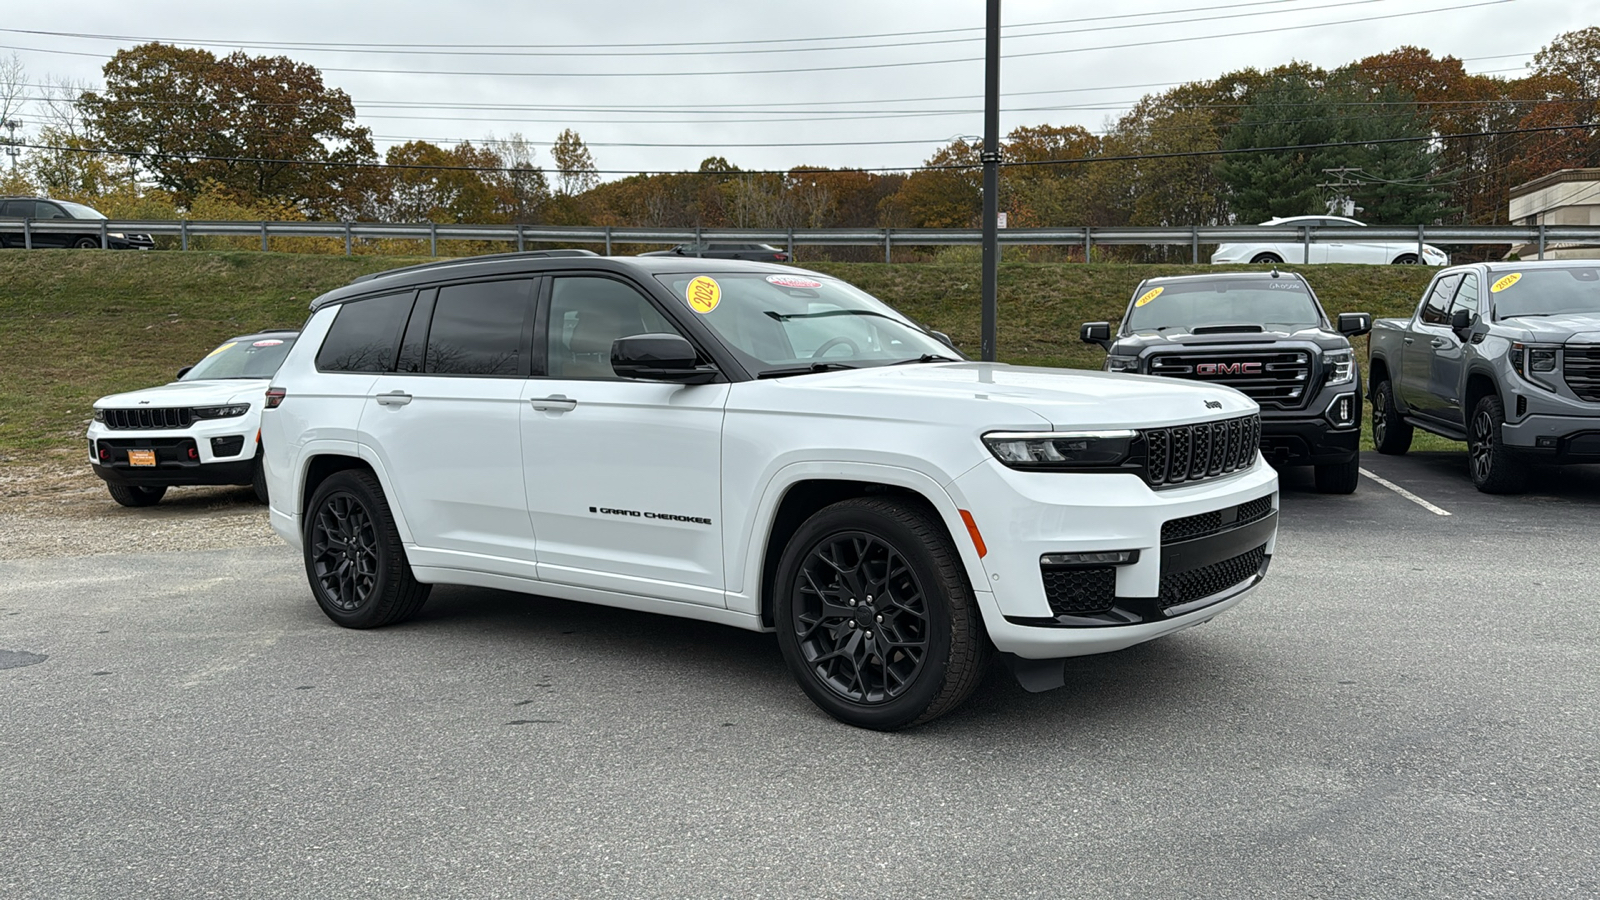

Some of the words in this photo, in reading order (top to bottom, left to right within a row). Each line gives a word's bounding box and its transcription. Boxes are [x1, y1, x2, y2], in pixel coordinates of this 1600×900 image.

[1496, 275, 1517, 290] 2024
[693, 279, 715, 308] 2024
[1197, 362, 1262, 375] GMC
[600, 507, 641, 517] GRAND
[644, 511, 712, 525] CHEROKEE
